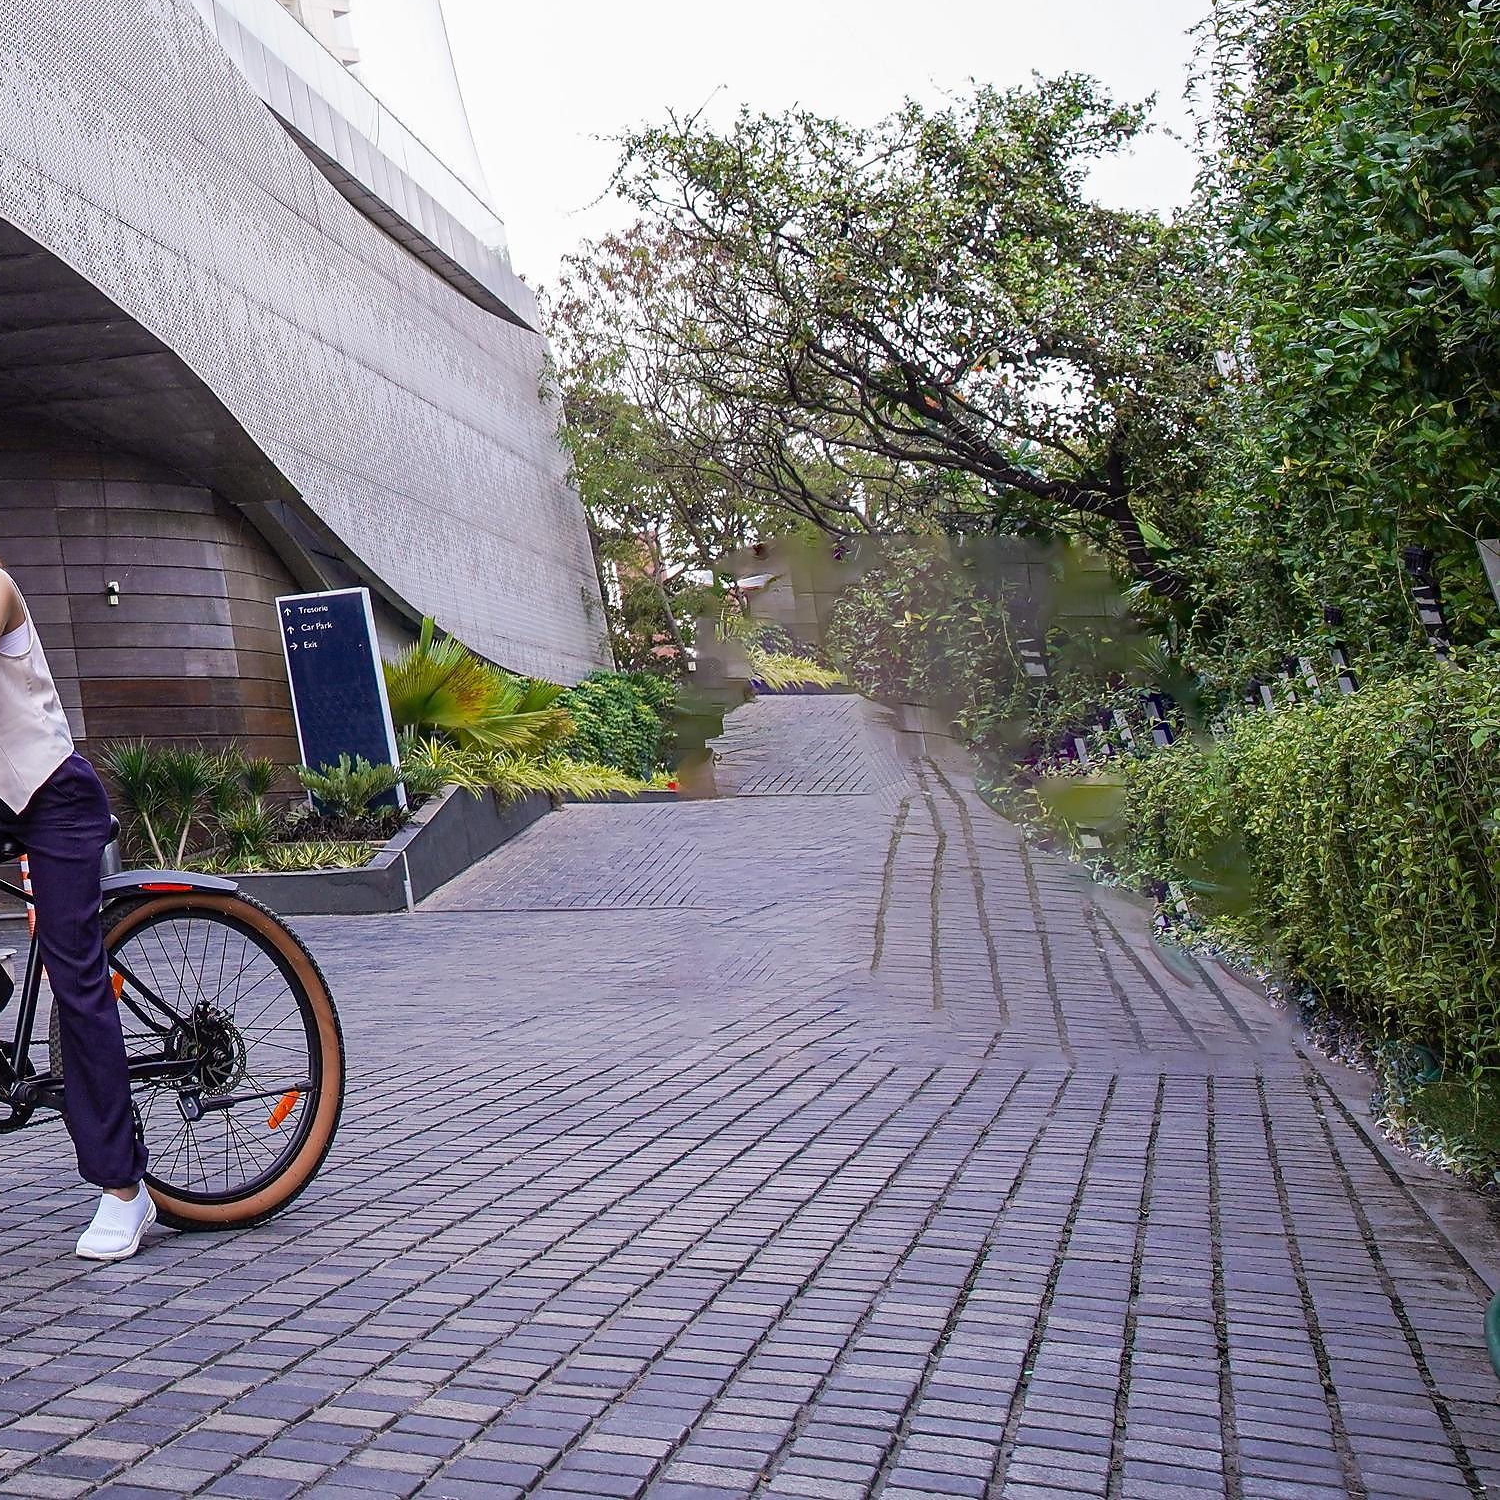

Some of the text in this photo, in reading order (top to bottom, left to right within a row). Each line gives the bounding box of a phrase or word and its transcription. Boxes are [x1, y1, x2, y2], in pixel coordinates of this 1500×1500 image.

[300, 620, 333, 632] Car Park
[303, 640, 318, 649] Exit
